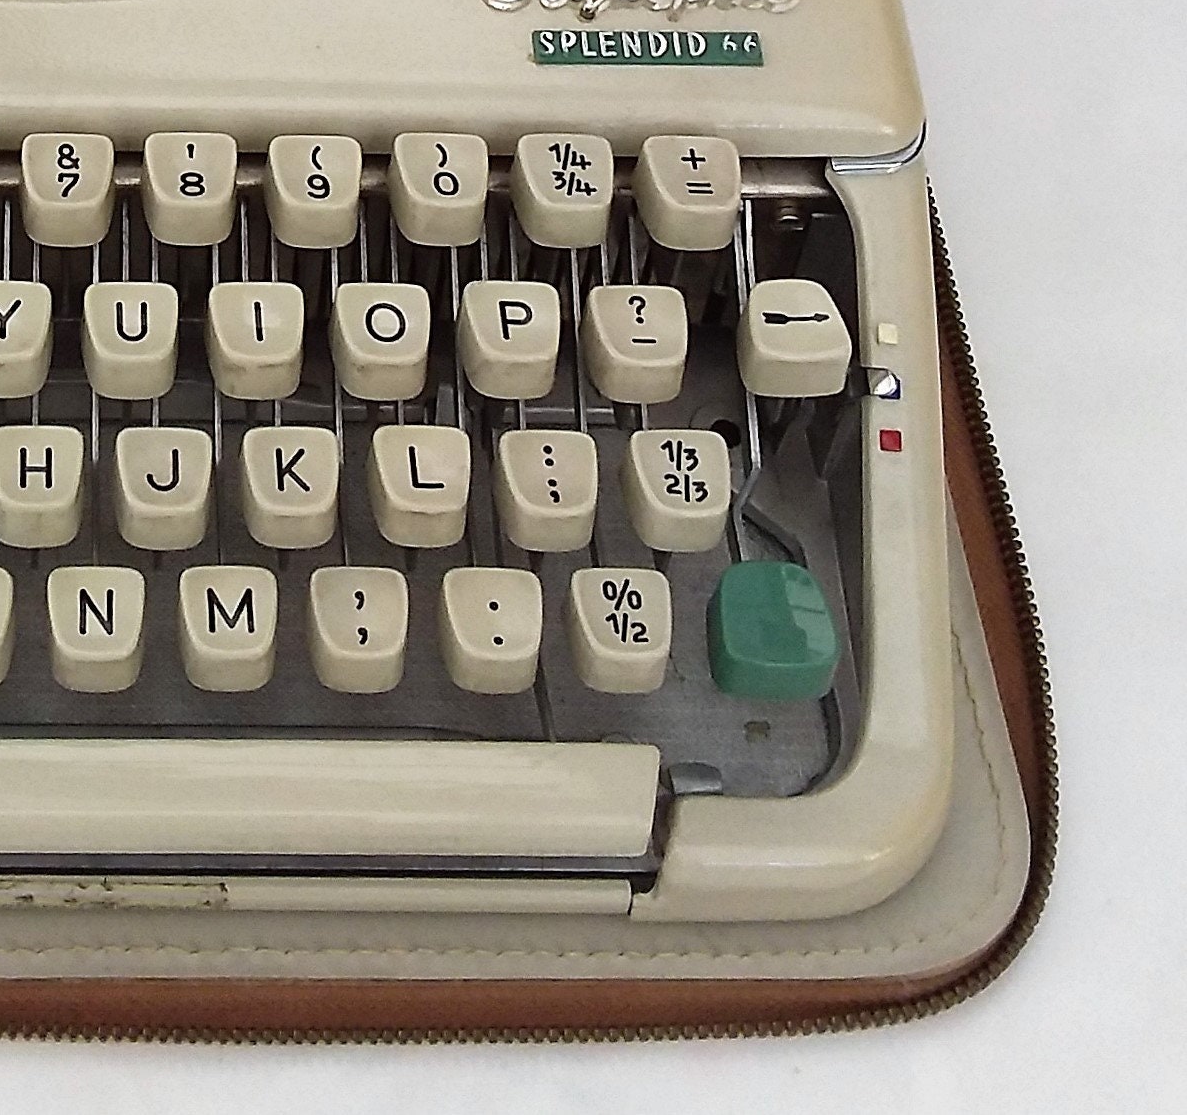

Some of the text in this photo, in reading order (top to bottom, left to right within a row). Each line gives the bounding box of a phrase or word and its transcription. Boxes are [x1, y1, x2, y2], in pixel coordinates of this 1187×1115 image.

[539, 31, 707, 58] SPLENDID
[57, 143, 80, 170] &
[57, 172, 80, 198] 7
[179, 171, 206, 197] 8
[306, 174, 331, 199] 9
[433, 171, 459, 196] 0
[115, 301, 148, 342] U
[253, 301, 264, 342] I
[365, 302, 406, 343] O
[498, 300, 533, 341] P
[628, 295, 646, 324] ?
[19, 447, 53, 489] H
[146, 448, 180, 492] J
[275, 447, 311, 493] K
[408, 445, 445, 489] L
[79, 588, 114, 636] N
[206, 587, 255, 634] M
